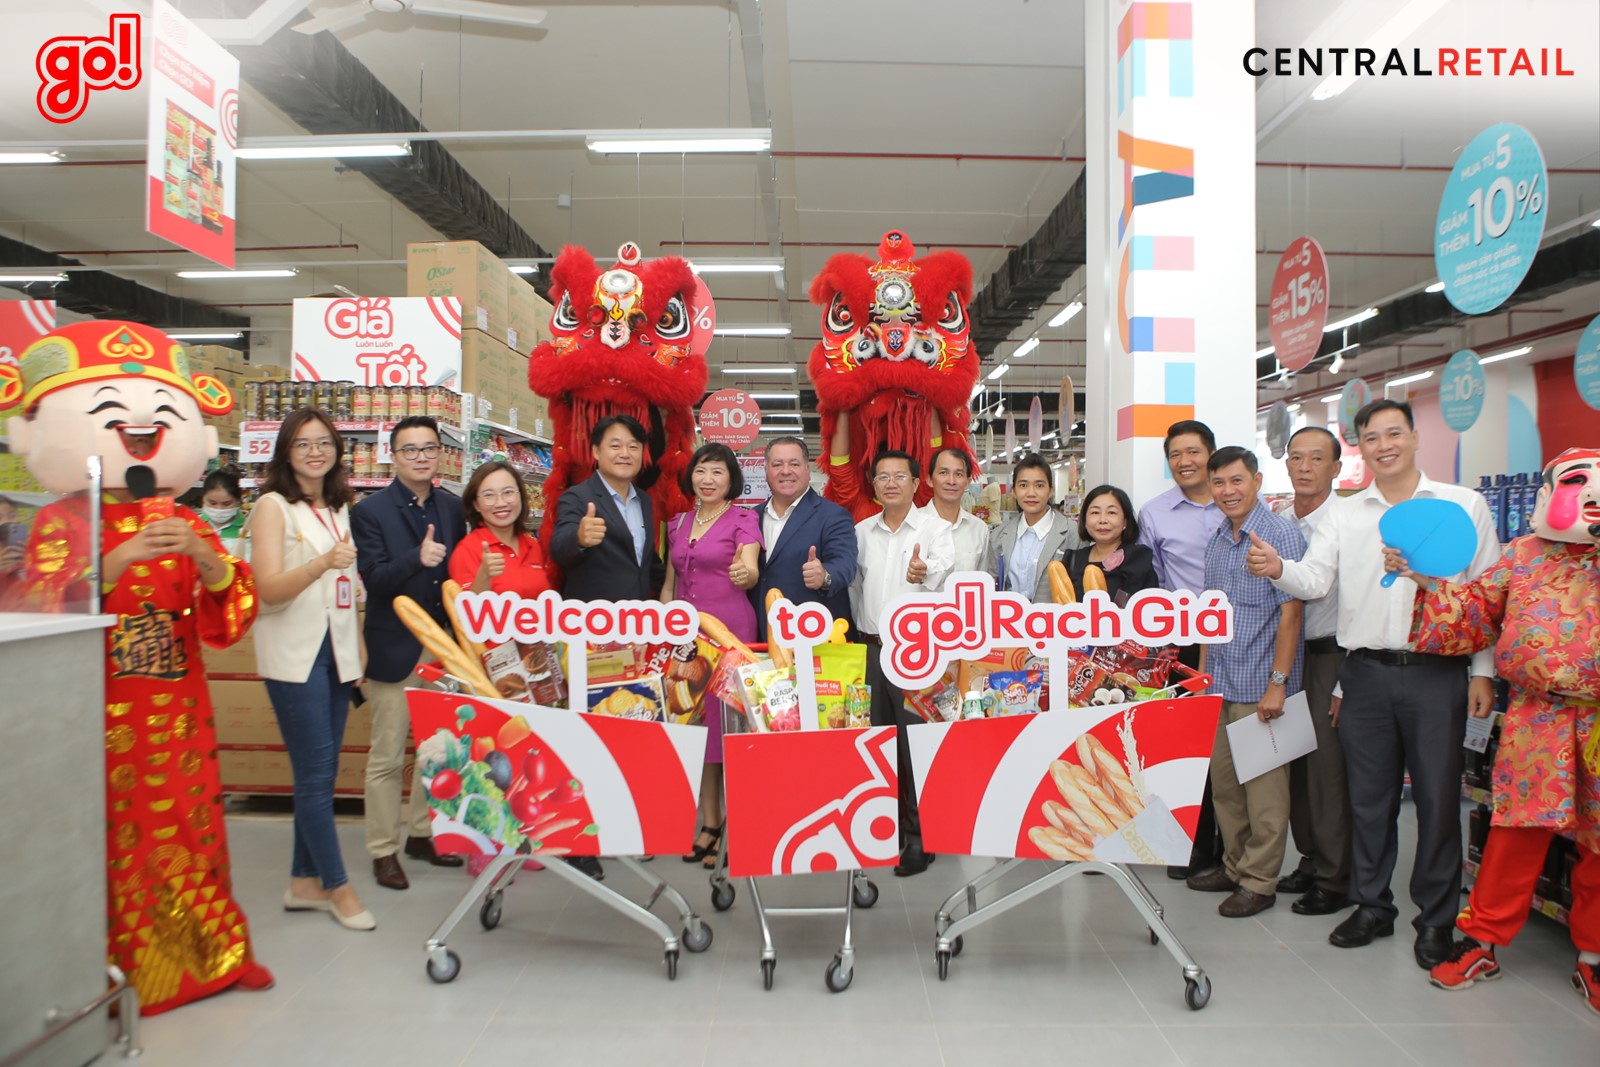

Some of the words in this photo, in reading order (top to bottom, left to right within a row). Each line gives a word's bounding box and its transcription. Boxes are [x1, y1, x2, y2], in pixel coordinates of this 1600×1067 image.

[1495, 132, 1512, 170] 5
[1467, 173, 1543, 247] 10%
[1301, 240, 1311, 267] 5
[1287, 271, 1324, 319] 15%
[327, 298, 391, 337] Giá
[357, 345, 425, 386] Tốt
[736, 392, 745, 405] 5
[701, 419, 720, 427] THÊM
[719, 407, 760, 429] 10%
[249, 440, 271, 455] 52
[463, 598, 691, 637] Welcome
[776, 606, 825, 640] to
[895, 586, 982, 676] go!
[991, 597, 1121, 650] Rạch
[1132, 596, 1228, 638] Giá
